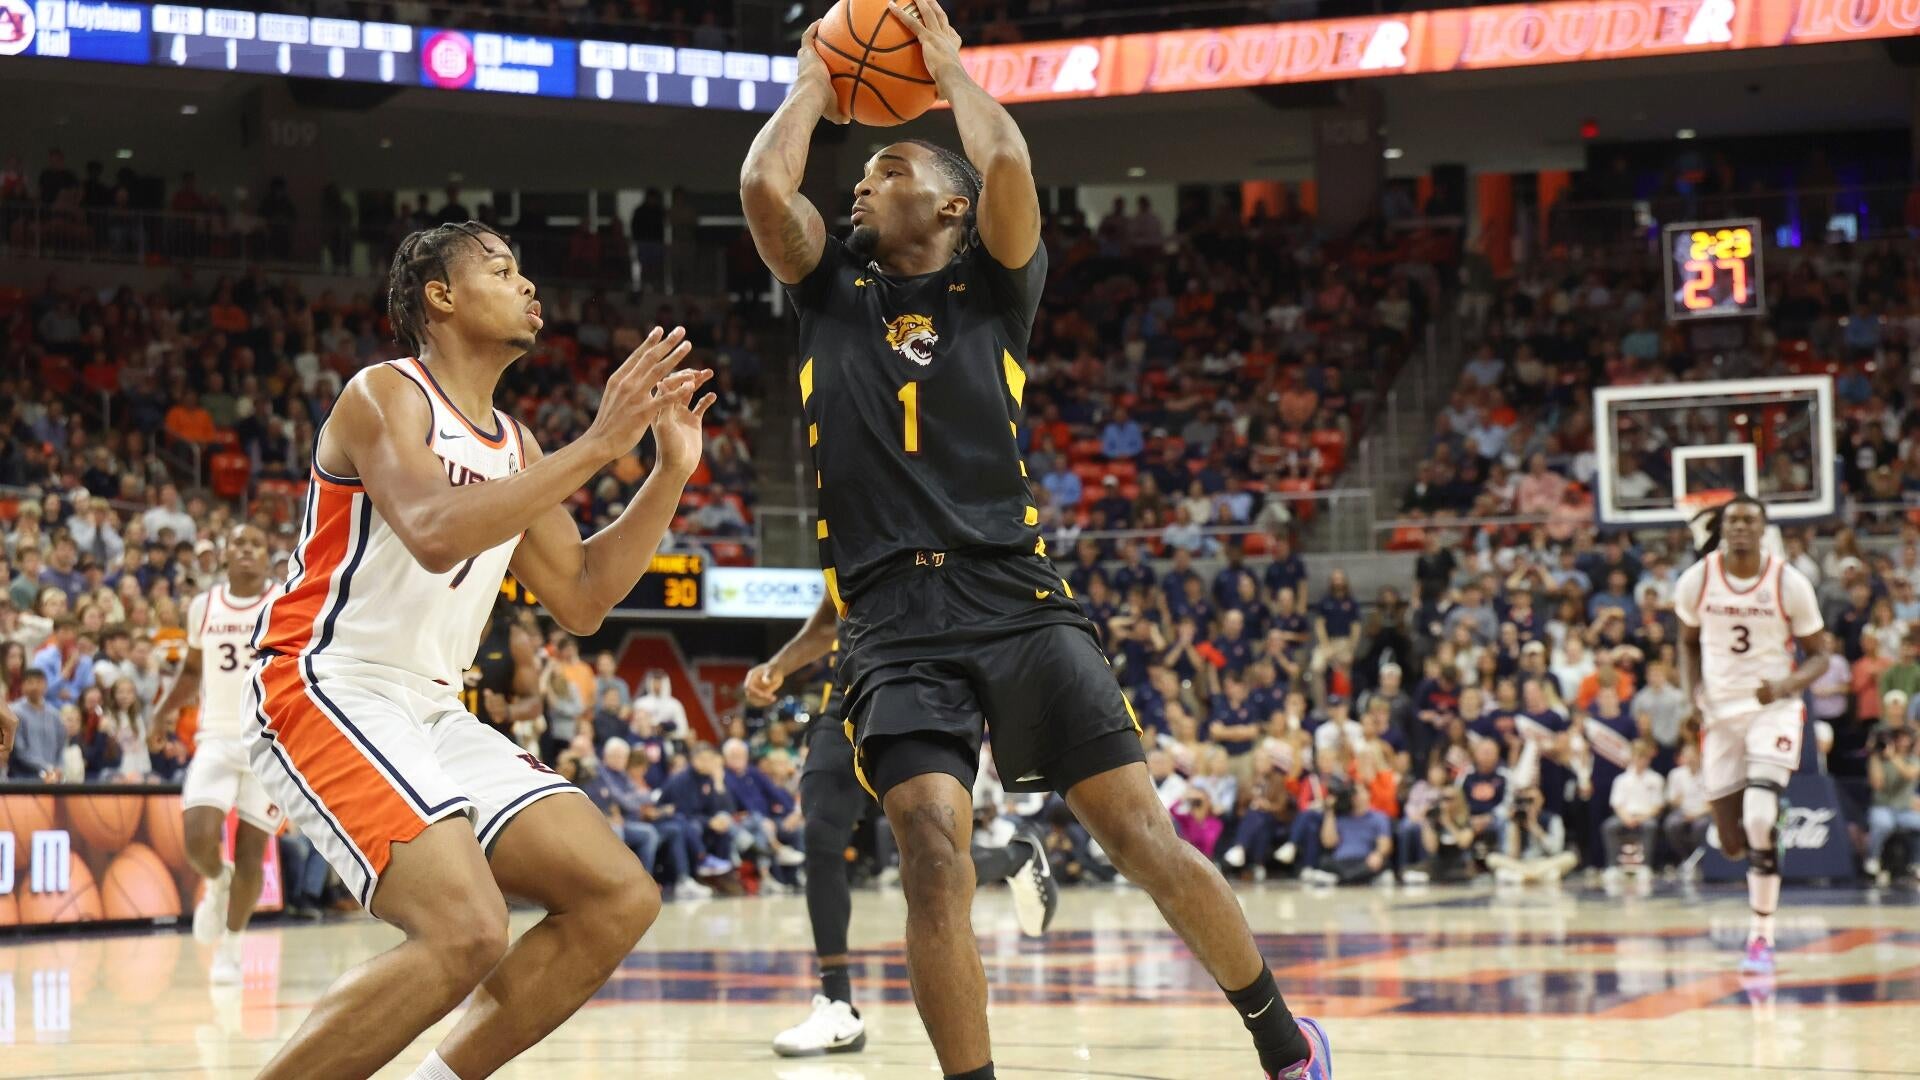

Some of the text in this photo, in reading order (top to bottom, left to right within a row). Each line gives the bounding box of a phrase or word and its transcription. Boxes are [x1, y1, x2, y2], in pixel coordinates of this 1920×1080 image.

[1151, 20, 1409, 86] LOUDER
[1461, 0, 1735, 62] LOUDER
[959, 45, 1100, 97] DER
[1683, 257, 1747, 310] 27
[897, 379, 920, 452] 1
[664, 577, 697, 608] 30
[1730, 624, 1751, 654] 3
